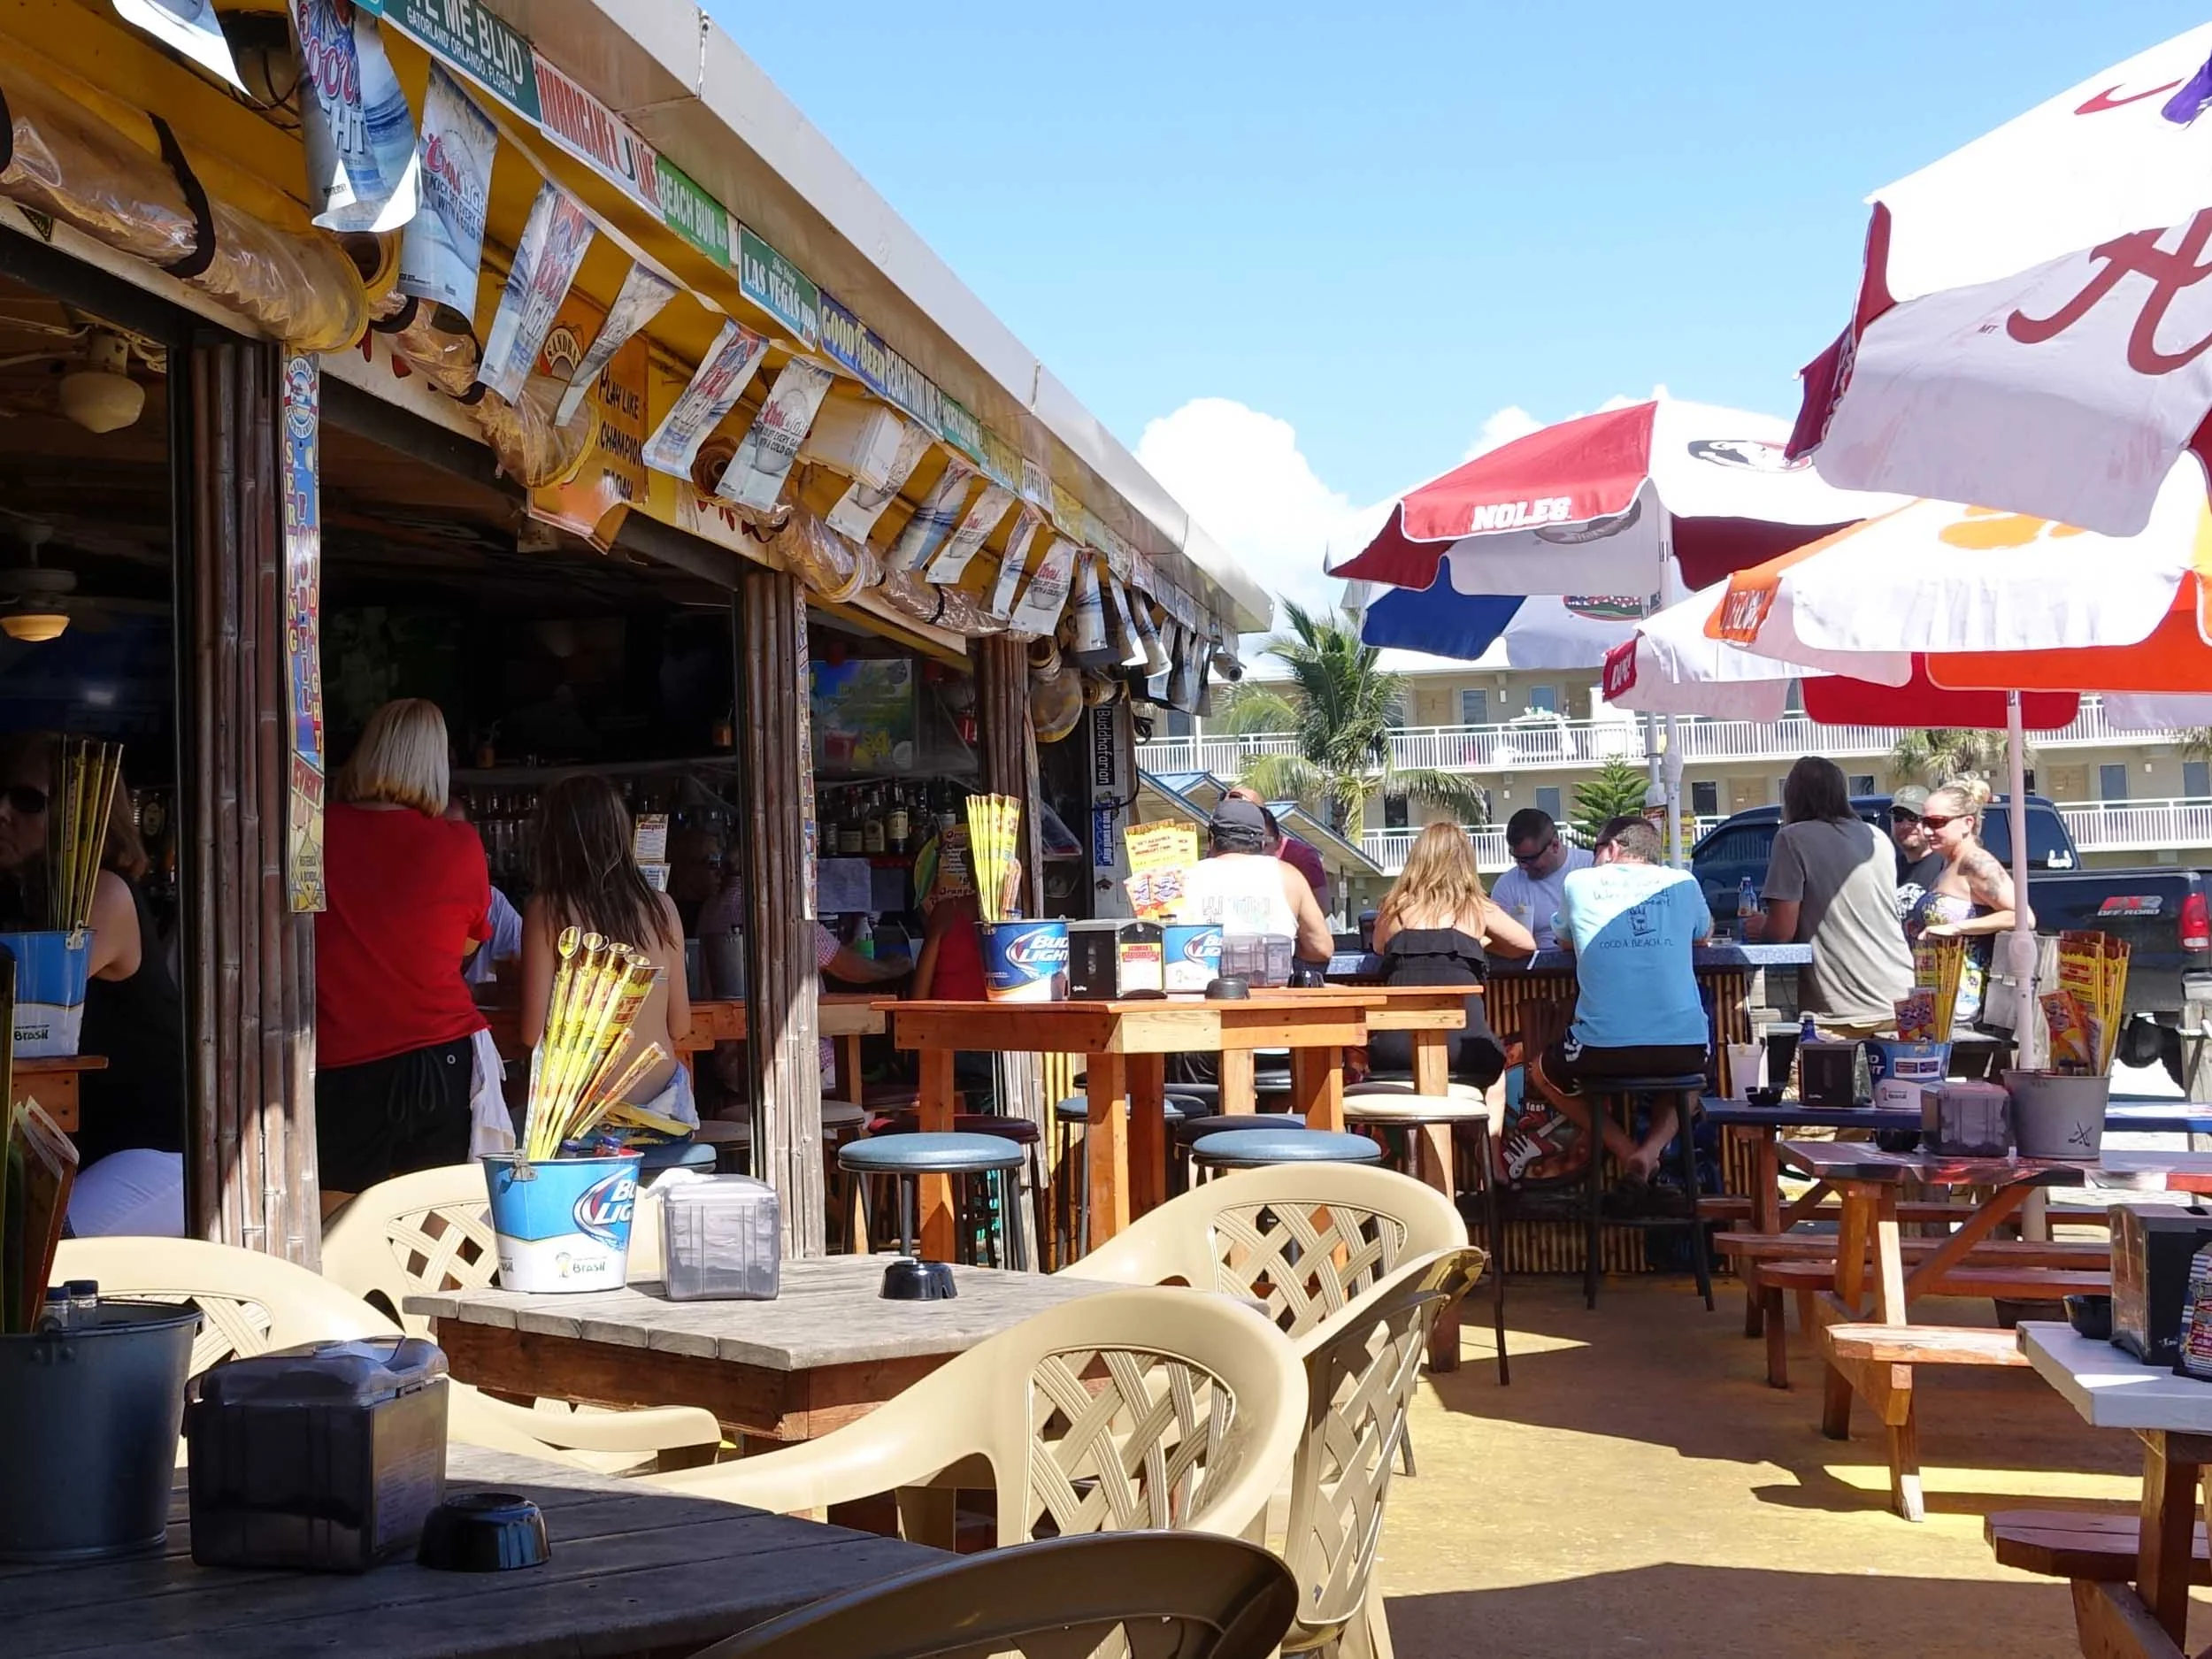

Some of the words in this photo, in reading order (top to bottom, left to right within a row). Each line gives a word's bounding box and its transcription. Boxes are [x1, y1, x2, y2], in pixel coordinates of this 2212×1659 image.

[476, 9, 524, 85] BLVD
[488, 65, 517, 101] FLORIDA
[535, 61, 618, 173] HURRICANE
[459, 175, 487, 219] LIGH
[658, 169, 695, 232] BEACH
[695, 196, 717, 250] BUM
[743, 252, 766, 296] LAS
[767, 268, 802, 322] VEGAS
[821, 304, 856, 358] GOOD
[860, 335, 887, 388] BEER
[597, 362, 621, 409] PLAY
[621, 391, 639, 420] LIKE
[601, 420, 644, 468] CHAMPION
[1471, 496, 1571, 532] NOLES
[1095, 709, 1113, 786] Buddhafarian
[1191, 943, 1222, 958] LIG
[1204, 933, 1222, 947] BU
[13, 1028, 50, 1041] Brasil
[610, 1179, 639, 1202] BU
[593, 1202, 634, 1225] LIG
[572, 1261, 606, 1273] Brasil
